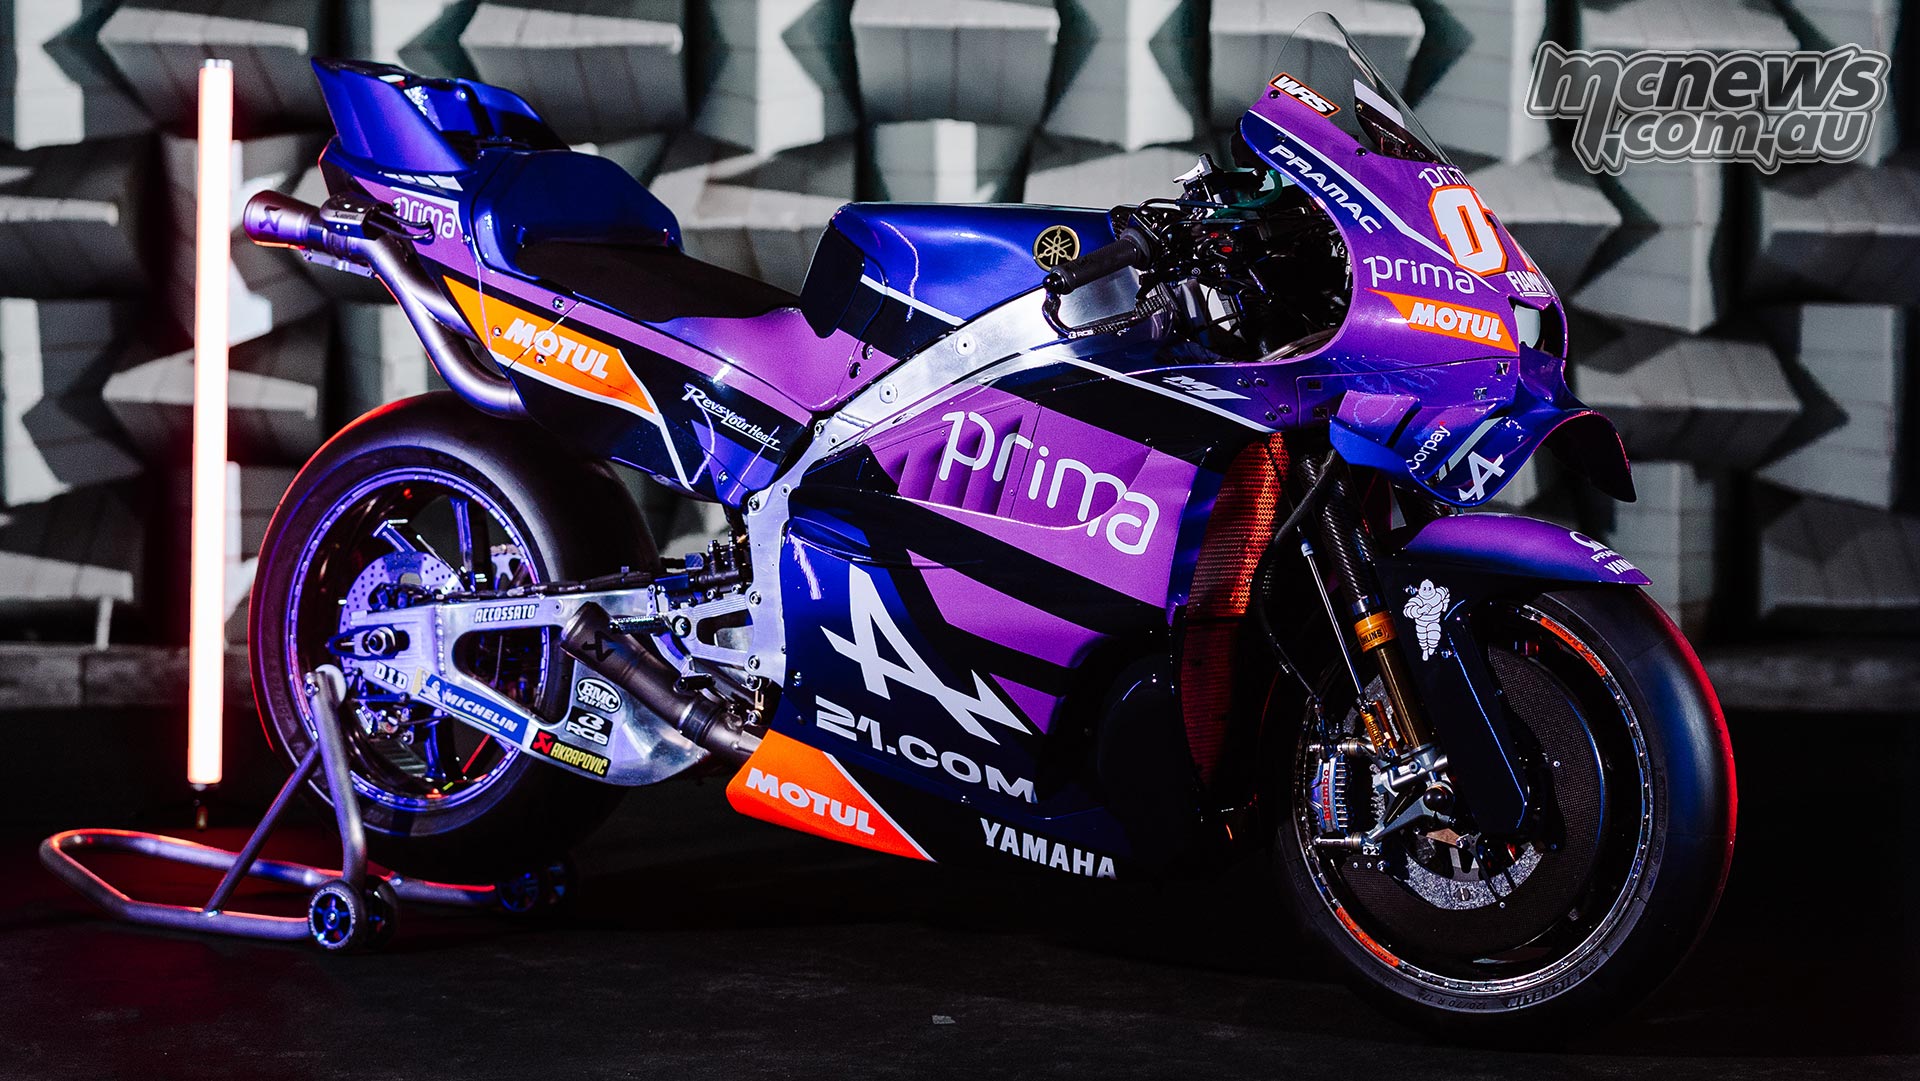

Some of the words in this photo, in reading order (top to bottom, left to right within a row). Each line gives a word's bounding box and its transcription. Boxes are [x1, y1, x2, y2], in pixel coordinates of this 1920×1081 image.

[1273, 74, 1337, 115] WRS
[1268, 144, 1383, 235] PRAMAC
[1418, 166, 1470, 189] prim
[1362, 255, 1475, 295] prima
[1406, 301, 1503, 342] MOTUL
[503, 317, 609, 379] MOTUL
[681, 382, 728, 415] Revs
[749, 424, 781, 449] Heart
[1406, 425, 1451, 471] Corpay
[938, 410, 1160, 556] prima
[474, 603, 537, 623] ACCOSSATO
[442, 689, 518, 733] MICHELIN
[582, 682, 618, 709] BMC
[566, 720, 608, 746] RCB
[815, 694, 1039, 804] 21.COM
[745, 768, 877, 836] MOTUL
[1321, 769, 1332, 821] brembo
[980, 817, 1117, 881] YAMAHA
